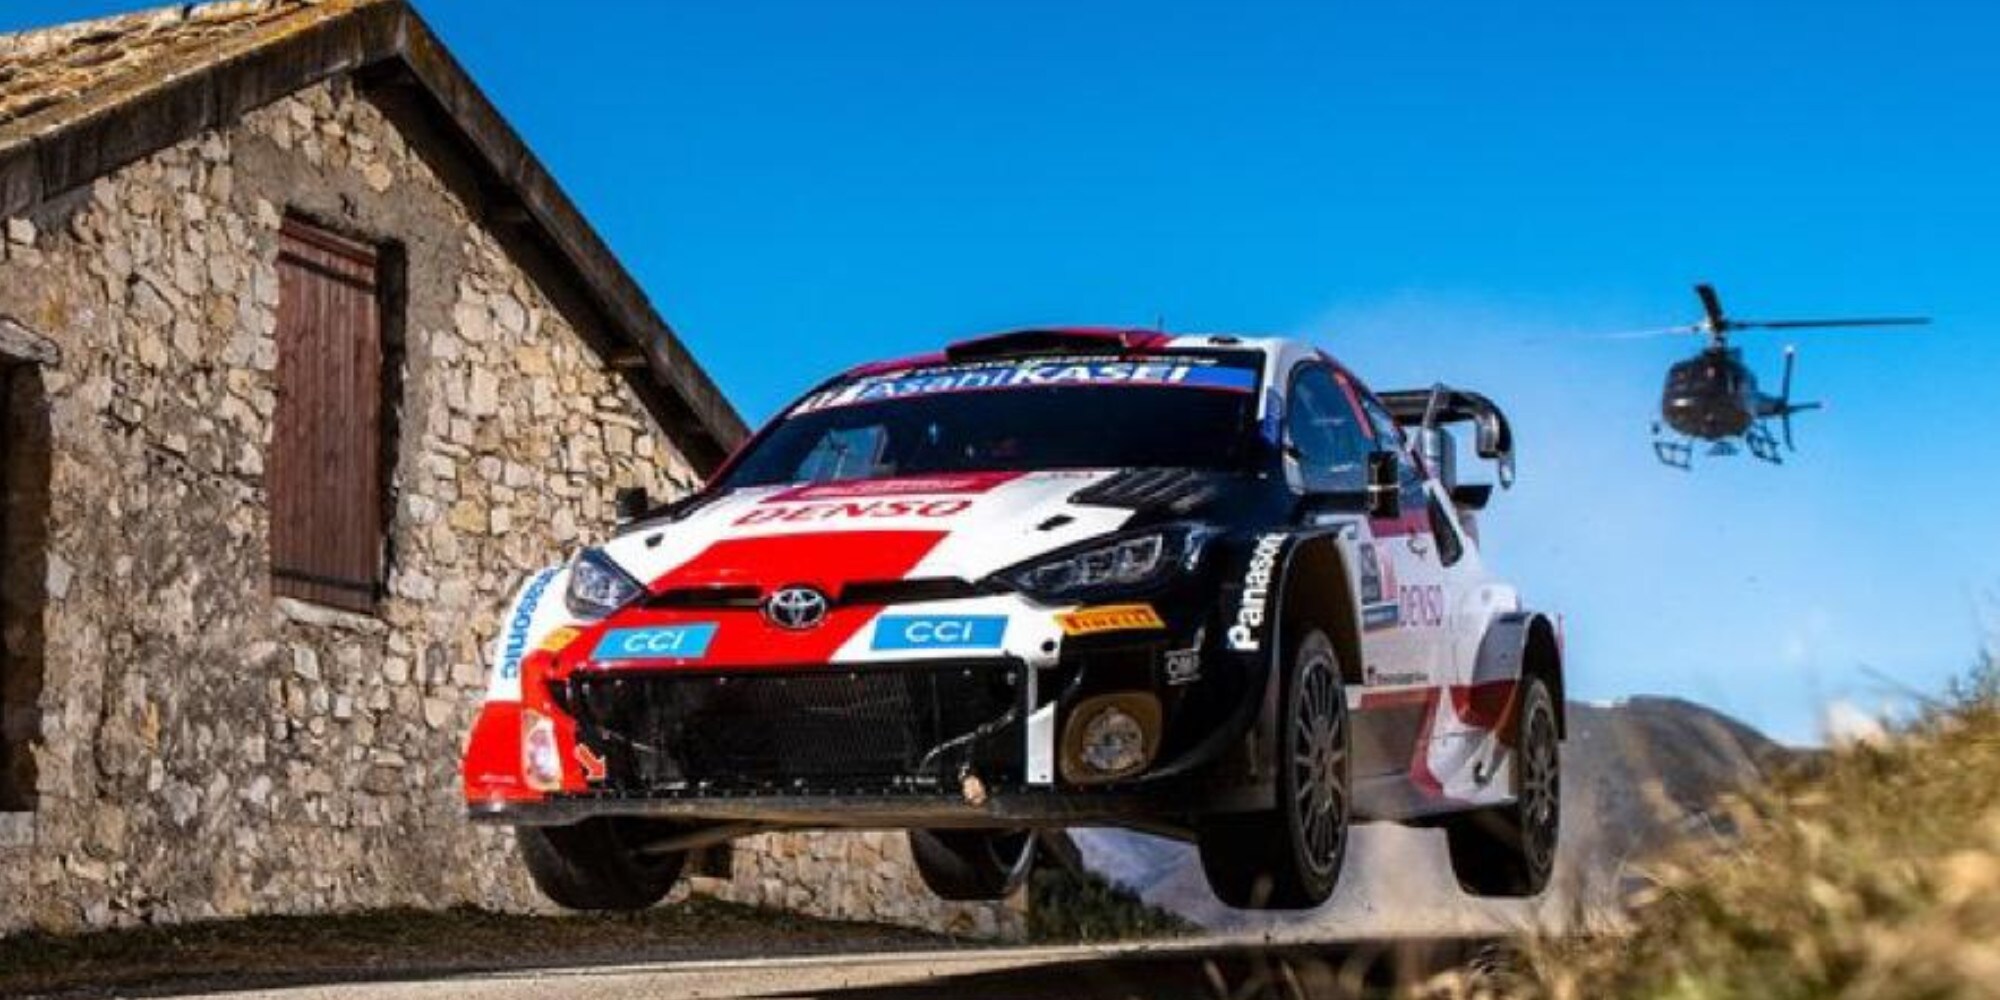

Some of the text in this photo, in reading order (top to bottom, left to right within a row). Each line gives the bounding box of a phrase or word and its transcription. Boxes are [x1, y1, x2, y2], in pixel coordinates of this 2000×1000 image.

[731, 499, 974, 527] DENSO
[623, 630, 685, 653] CCI
[904, 620, 973, 643] CCI
